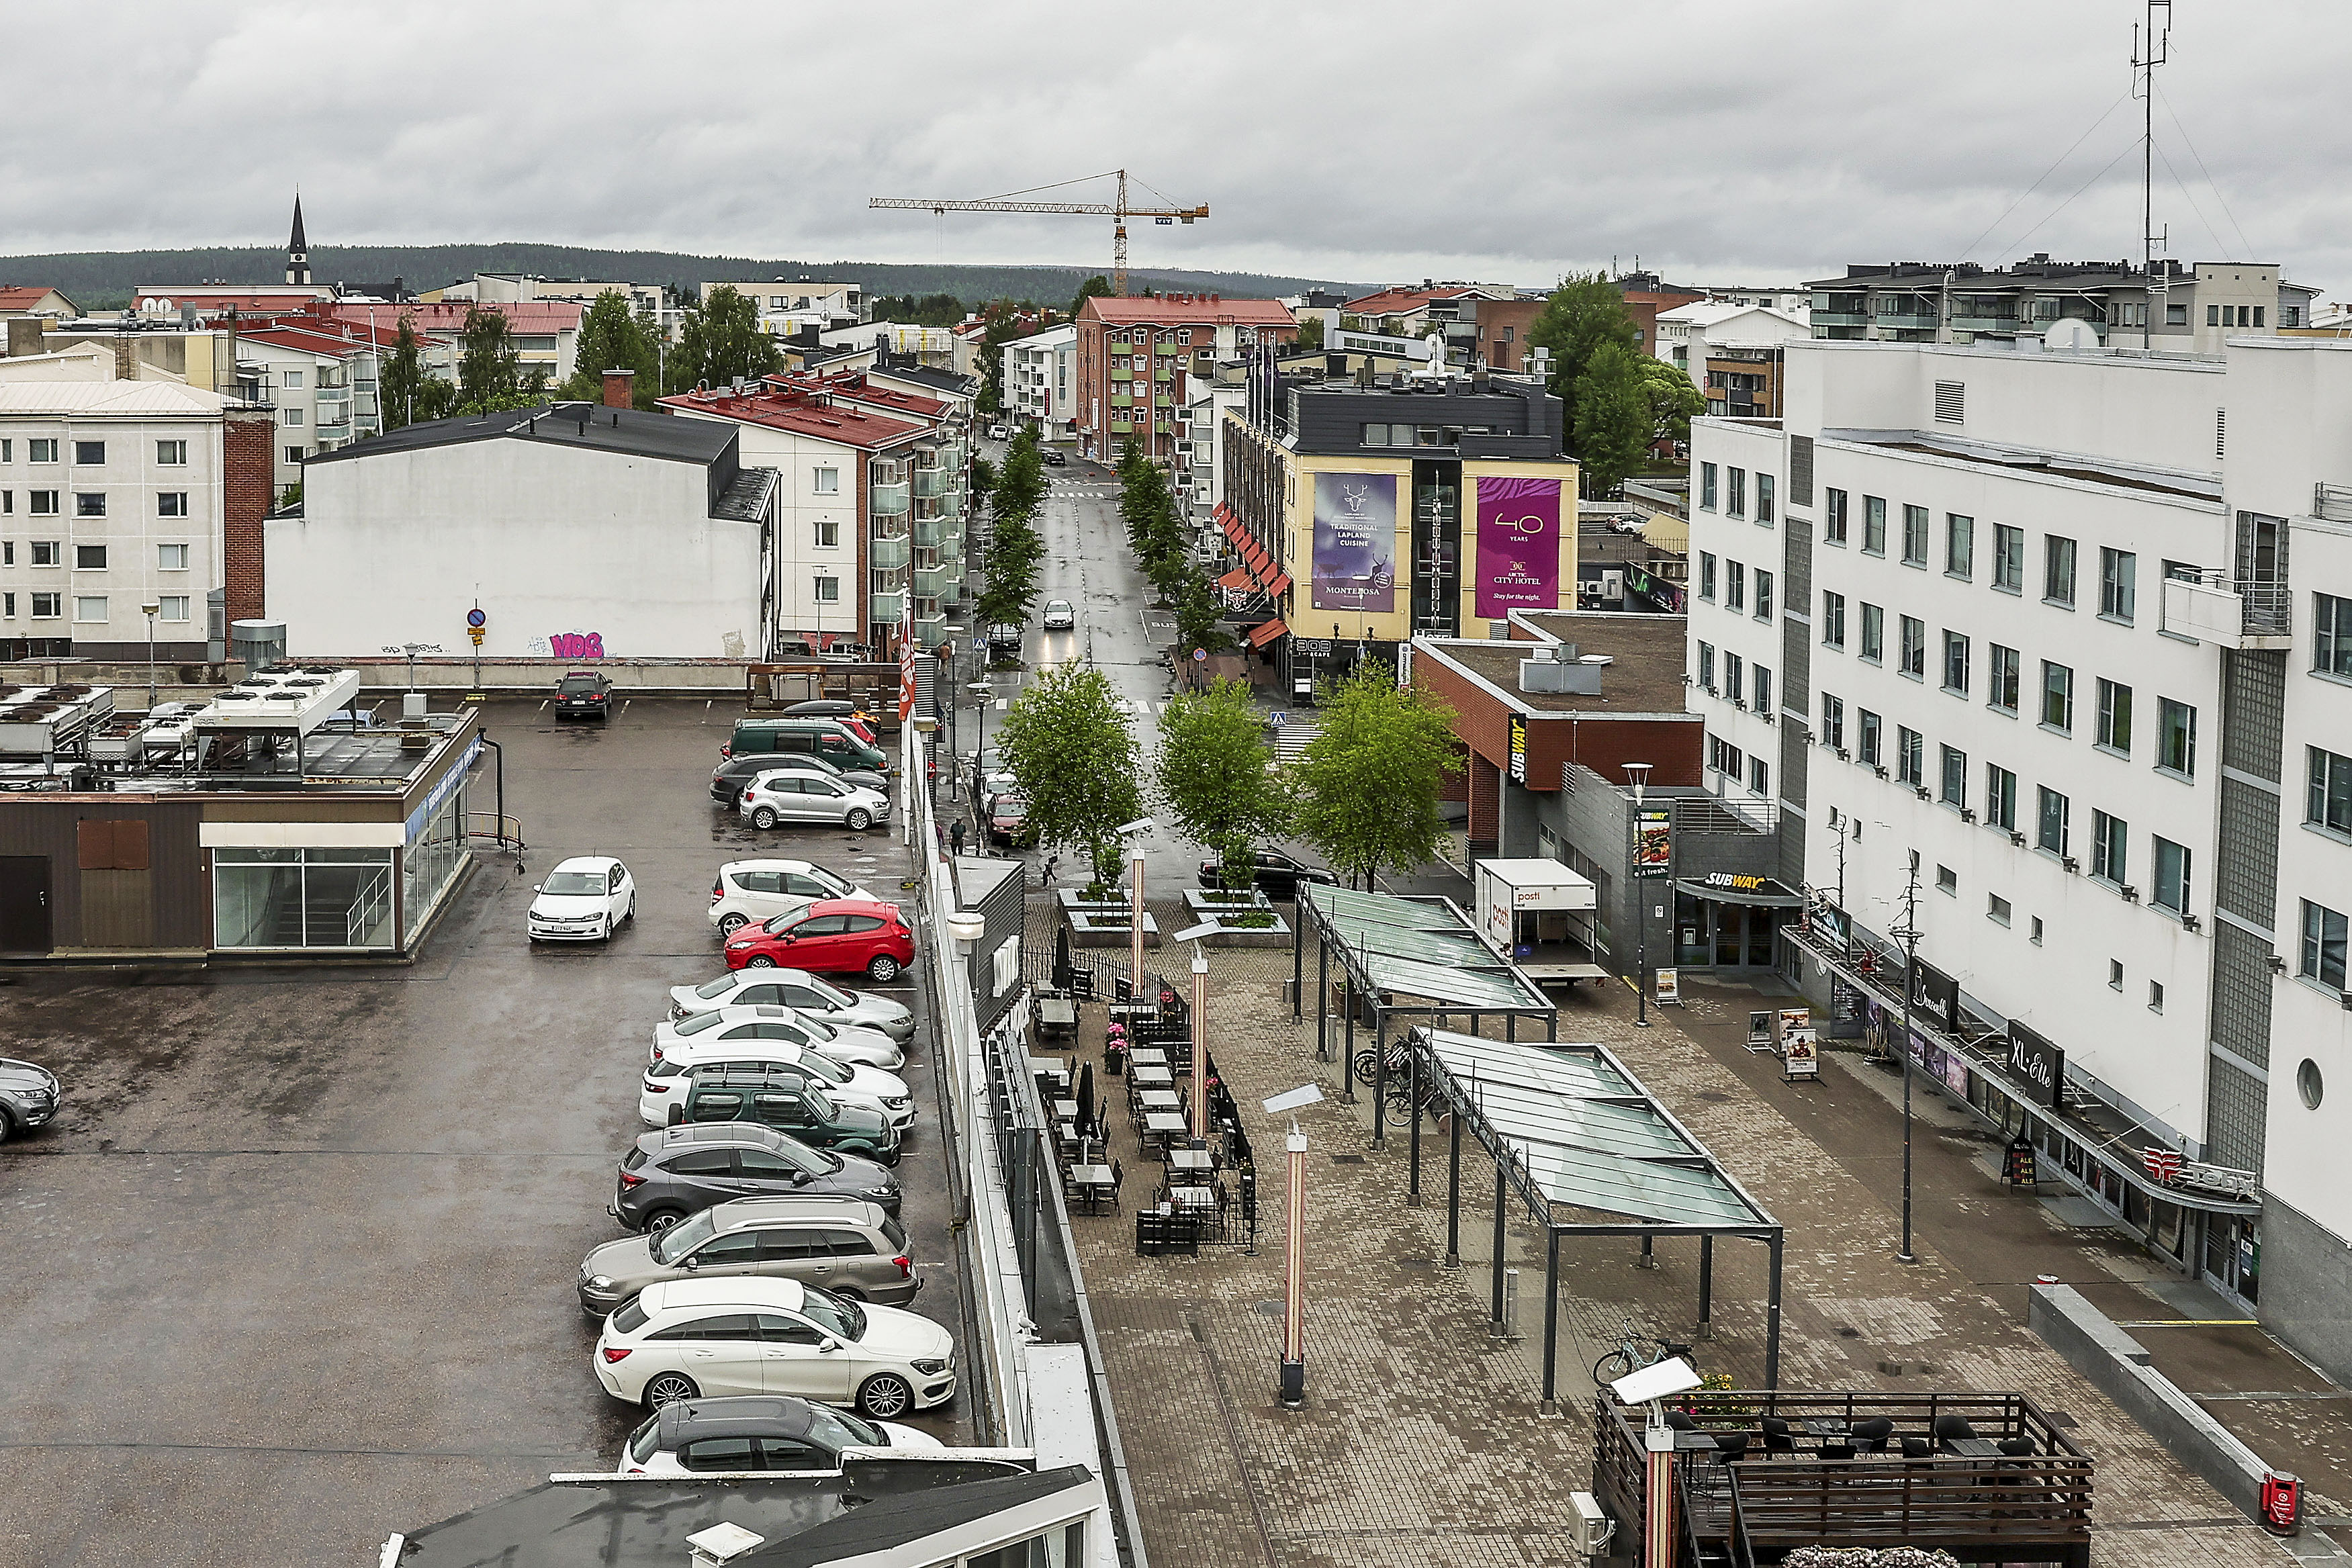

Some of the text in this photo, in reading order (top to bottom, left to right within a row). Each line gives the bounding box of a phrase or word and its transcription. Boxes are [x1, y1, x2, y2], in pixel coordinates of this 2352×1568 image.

[1495, 513, 1543, 534] 40
[1510, 718, 1526, 784] SUBWAY
[1635, 811, 1669, 820] UBWAY
[1705, 872, 1766, 889] SUBWAY
[1518, 892, 1540, 903] posti
[1493, 903, 1509, 931] posti
